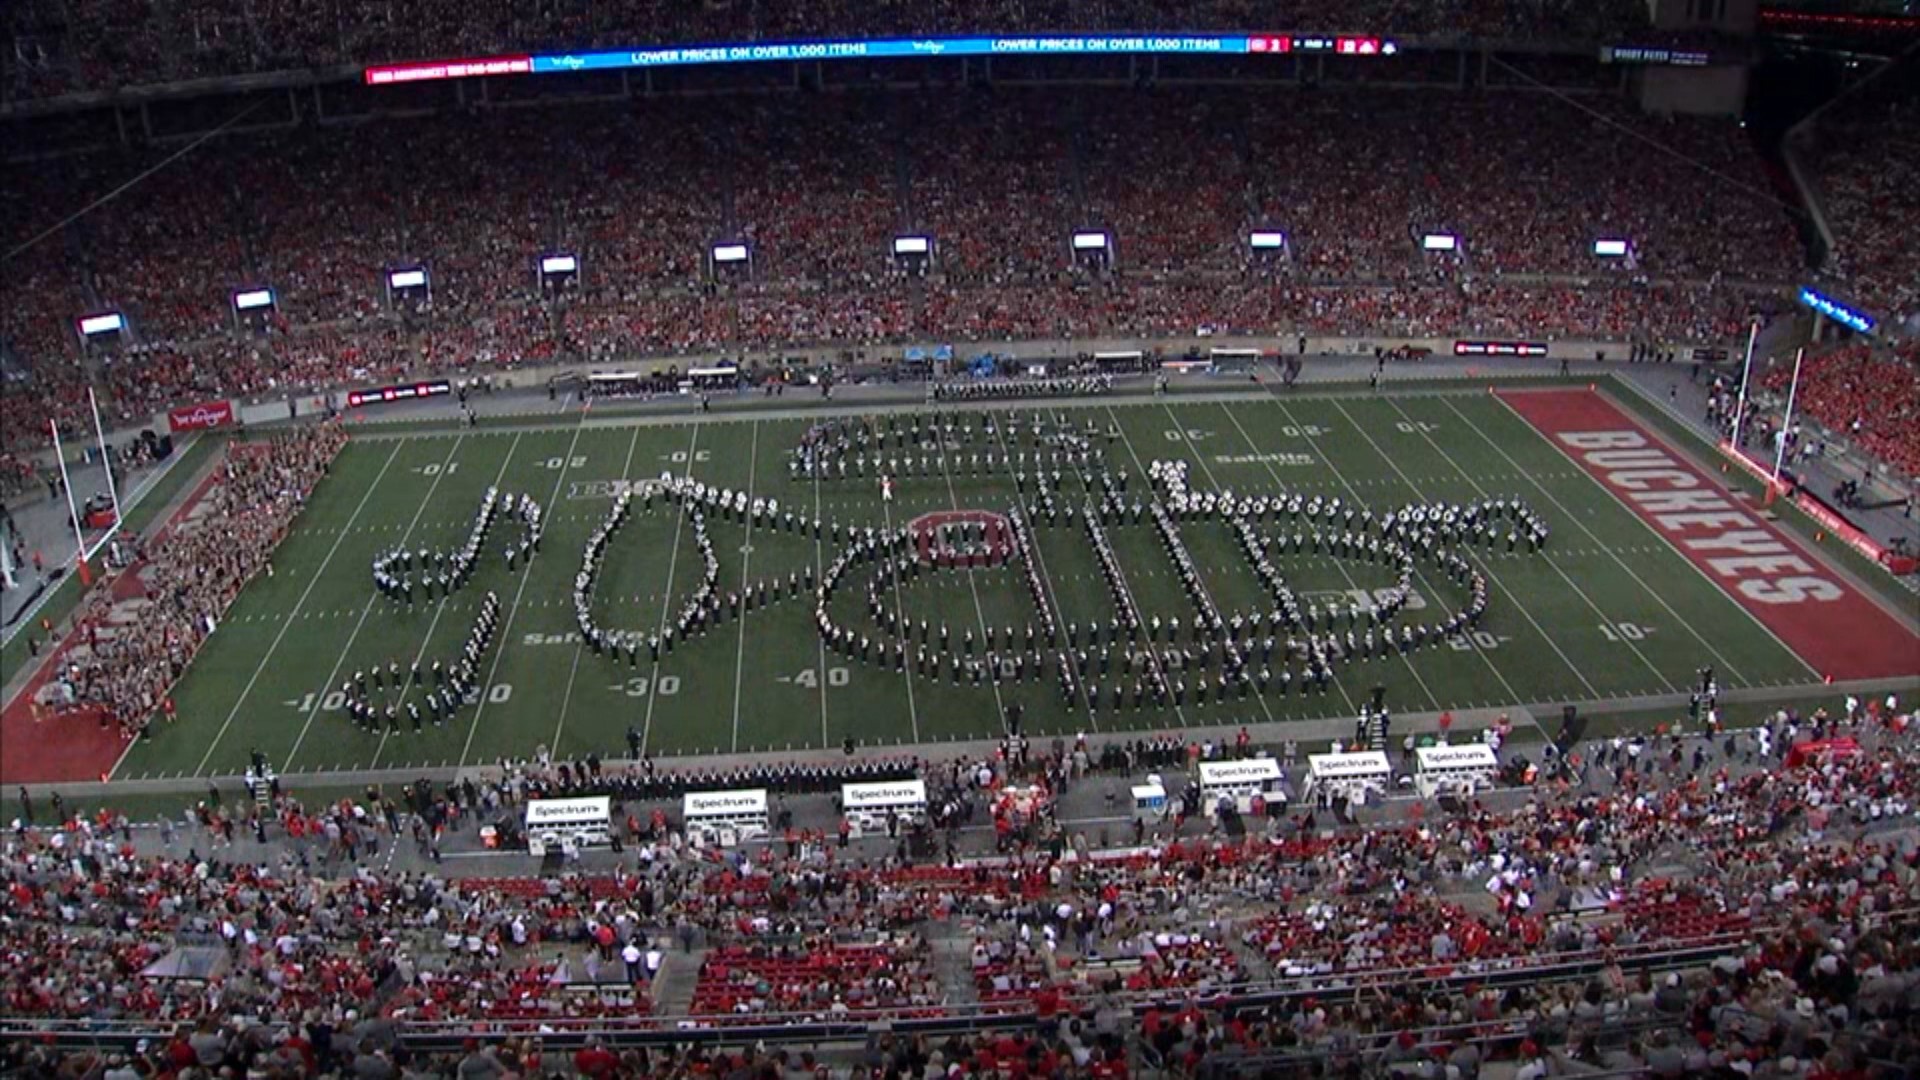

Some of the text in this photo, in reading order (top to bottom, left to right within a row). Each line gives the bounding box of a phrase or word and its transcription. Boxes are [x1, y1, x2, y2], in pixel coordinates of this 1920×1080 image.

[991, 38, 1221, 51] LOWER PRICES ON OVER 1,000 ITEMS
[631, 43, 868, 64] LOWER PRICES ON OVER 1,000 ITEMS
[1555, 430, 1845, 603] BUCKEYES
[1598, 622, 1645, 641] 10
[791, 667, 850, 688] 40
[625, 675, 681, 697] 30
[299, 692, 348, 712] 10
[1318, 758, 1380, 771] Spectrum
[1426, 751, 1486, 764] Spectrum
[1208, 766, 1270, 779] Spectrum
[851, 788, 916, 800] Spectrum
[535, 804, 599, 817] Spectrum
[692, 798, 758, 814] Spectrum
